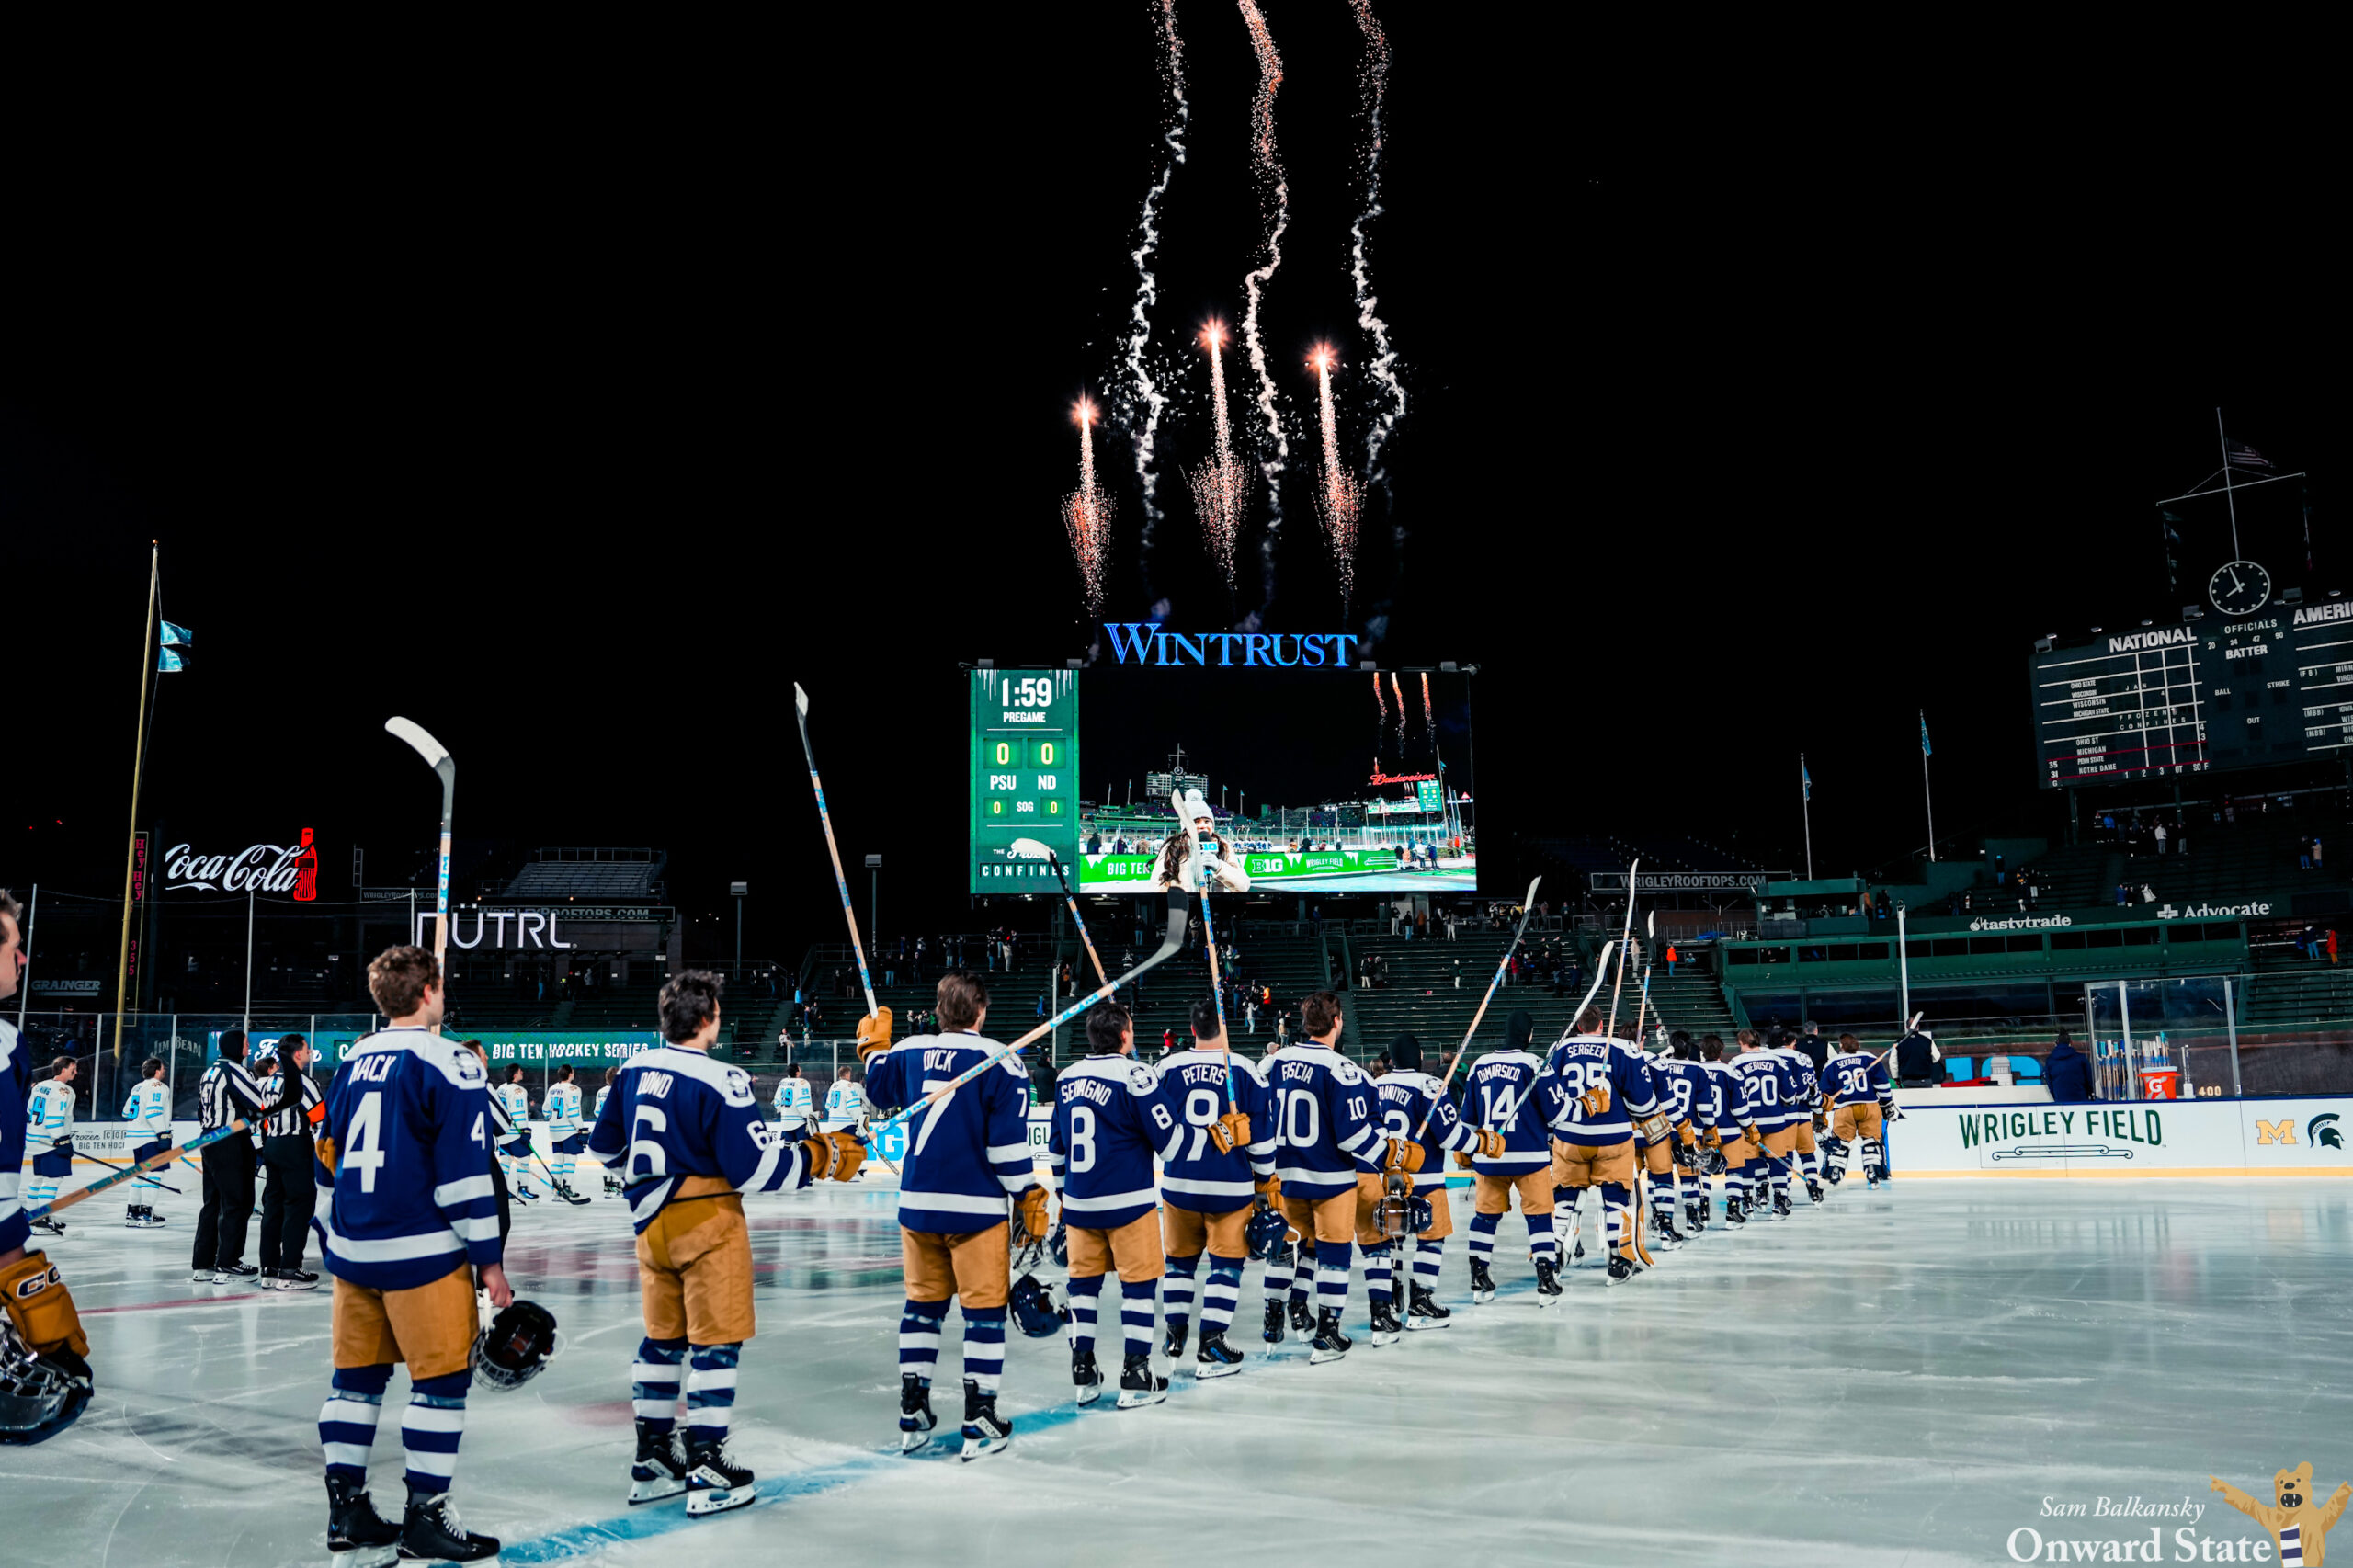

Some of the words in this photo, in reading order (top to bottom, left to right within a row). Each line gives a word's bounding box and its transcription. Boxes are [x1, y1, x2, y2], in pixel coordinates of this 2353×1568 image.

[2293, 601, 2353, 626] AMERI
[2224, 619, 2278, 634] OFFICIALS
[1104, 622, 1358, 667] WINTRUST
[2109, 626, 2198, 653] NATIONAL
[2225, 644, 2268, 660] BATTER
[1002, 677, 1052, 707] 1:59
[2214, 688, 2232, 697] BALL
[2267, 680, 2290, 689] STRIKE
[2072, 698, 2107, 710] WISCONSIN
[1003, 711, 1046, 723] PREGAME
[2246, 716, 2261, 725] OUT
[996, 742, 1010, 765] 0
[1040, 742, 1054, 765] 0
[2076, 745, 2107, 756] MICHIGAN
[2048, 760, 2059, 769] 35
[2078, 766, 2098, 776] NOTRE
[2099, 763, 2117, 773] DAME
[2141, 768, 2147, 778] 2
[2158, 767, 2165, 777] 3
[2175, 765, 2183, 774] OT
[990, 775, 1017, 790] PSU
[1038, 775, 1057, 790] ND
[993, 801, 1002, 814] 0
[1017, 801, 1034, 812] SOG
[1050, 801, 1058, 814] 0
[135, 838, 146, 868] Hey
[165, 843, 305, 892] Coca-Cola
[1107, 862, 1127, 875] BIG
[131, 870, 144, 901] Hey
[2184, 901, 2271, 918] Advocate
[30, 979, 101, 992] GRAINGER
[150, 1040, 170, 1058] JIM
[175, 1036, 202, 1058] BEAM
[492, 1043, 515, 1060] BIG
[518, 1042, 543, 1060] TEN
[548, 1043, 599, 1059] HOCKEY
[348, 1055, 397, 1085] MACK
[923, 1049, 957, 1073] DYCK
[1668, 1063, 1686, 1075] FINK
[636, 1071, 674, 1099] DOWD
[1181, 1064, 1227, 1086] PETERS
[1837, 1067, 1869, 1094] 30
[2148, 1078, 2163, 1094] G
[1017, 1087, 1028, 1118] 7
[1745, 1074, 1778, 1107] 20
[2198, 1085, 2222, 1096] 400
[914, 1080, 956, 1156] 7
[1151, 1103, 1173, 1130] 8
[1276, 1088, 1320, 1147] 10
[1347, 1096, 1368, 1121] 10
[1437, 1103, 1457, 1127] 13
[1481, 1085, 1518, 1132] 14
[470, 1111, 486, 1151] 4
[746, 1119, 772, 1151] 6
[1070, 1106, 1096, 1173] 8
[1959, 1110, 2075, 1150] WRIGLEY
[2086, 1108, 2163, 1147] FIELD
[2256, 1119, 2298, 1145] M
[78, 1142, 91, 1150] BIG
[93, 1142, 106, 1150] TEN
[342, 1091, 385, 1193] 4
[625, 1104, 667, 1185] 6
